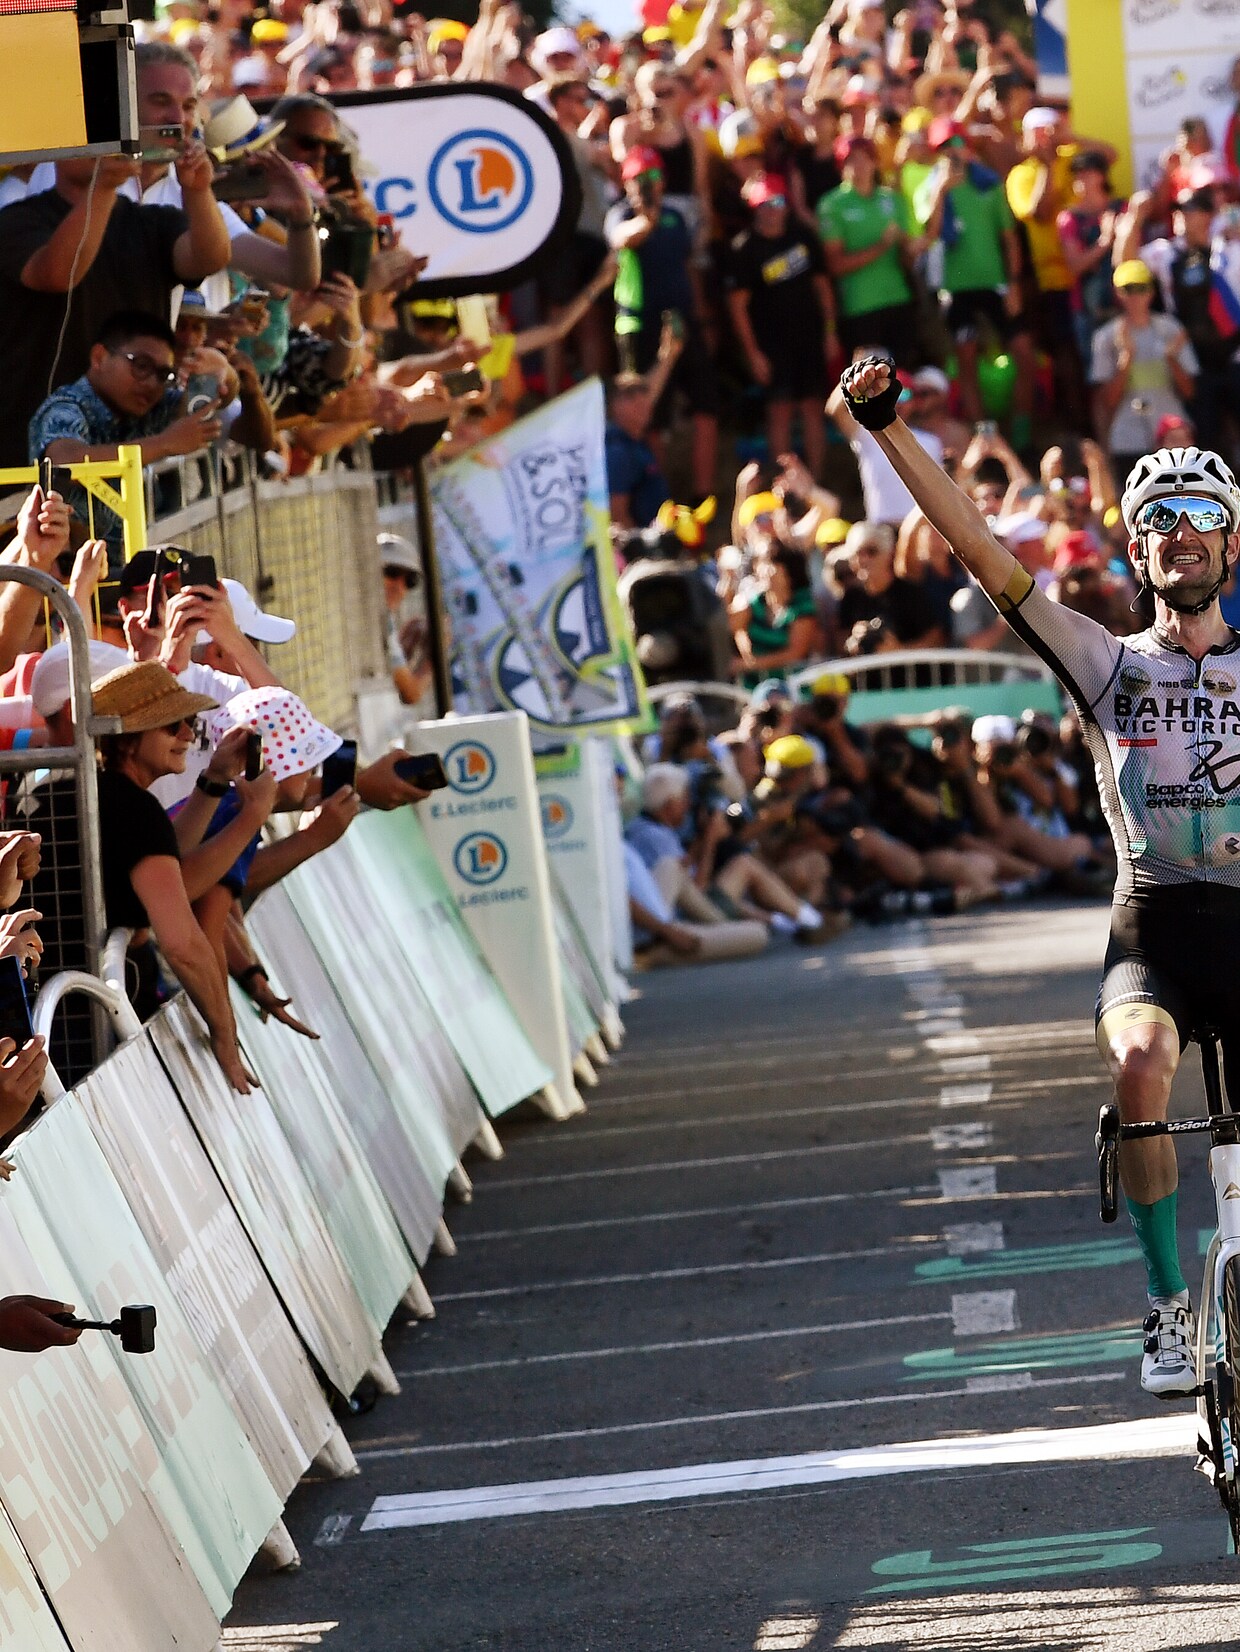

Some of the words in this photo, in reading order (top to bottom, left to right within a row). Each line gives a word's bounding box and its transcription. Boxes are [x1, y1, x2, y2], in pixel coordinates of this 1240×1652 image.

[1146, 784, 1205, 797] Bapco
[1146, 795, 1226, 810] energies
[1167, 1120, 1211, 1132] Vision
